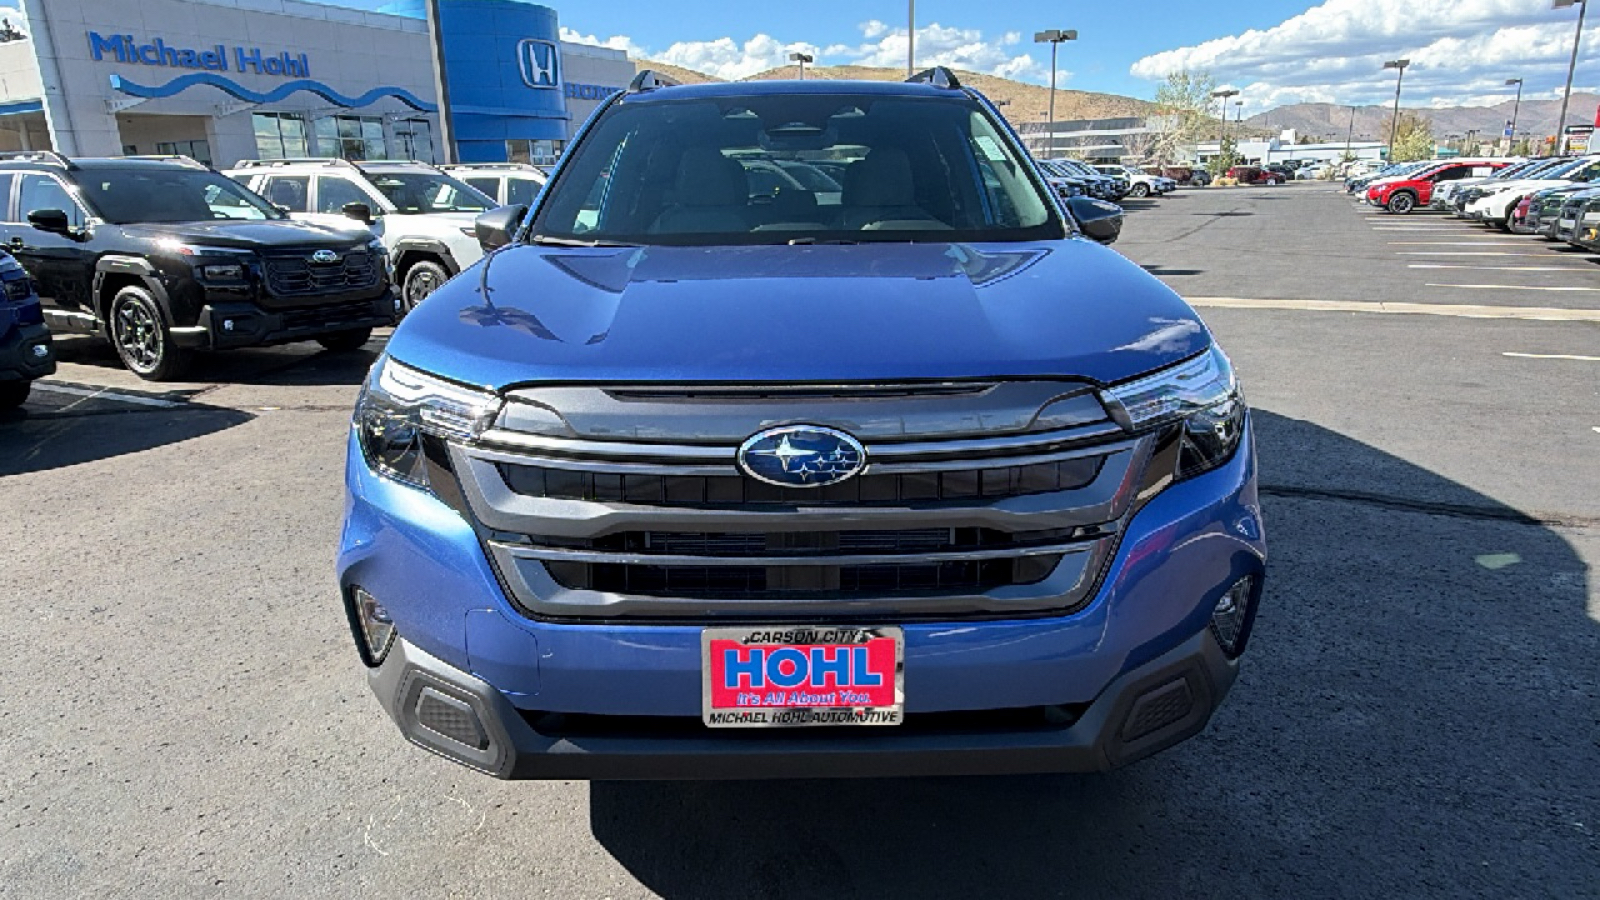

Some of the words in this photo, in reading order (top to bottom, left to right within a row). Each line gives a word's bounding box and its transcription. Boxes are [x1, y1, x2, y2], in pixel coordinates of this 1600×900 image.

[87, 31, 228, 71] Michael
[234, 46, 310, 77] Hohl
[750, 630, 818, 644] CARSON
[824, 629, 859, 644] CITY
[724, 646, 884, 688] HOHL
[736, 691, 760, 706] It's
[764, 691, 786, 705] All
[787, 691, 836, 705] About
[839, 689, 872, 704] You.
[708, 712, 768, 724] MICHAEL
[772, 711, 809, 724] HOHL
[812, 710, 898, 724] AUTOMOTIVE
